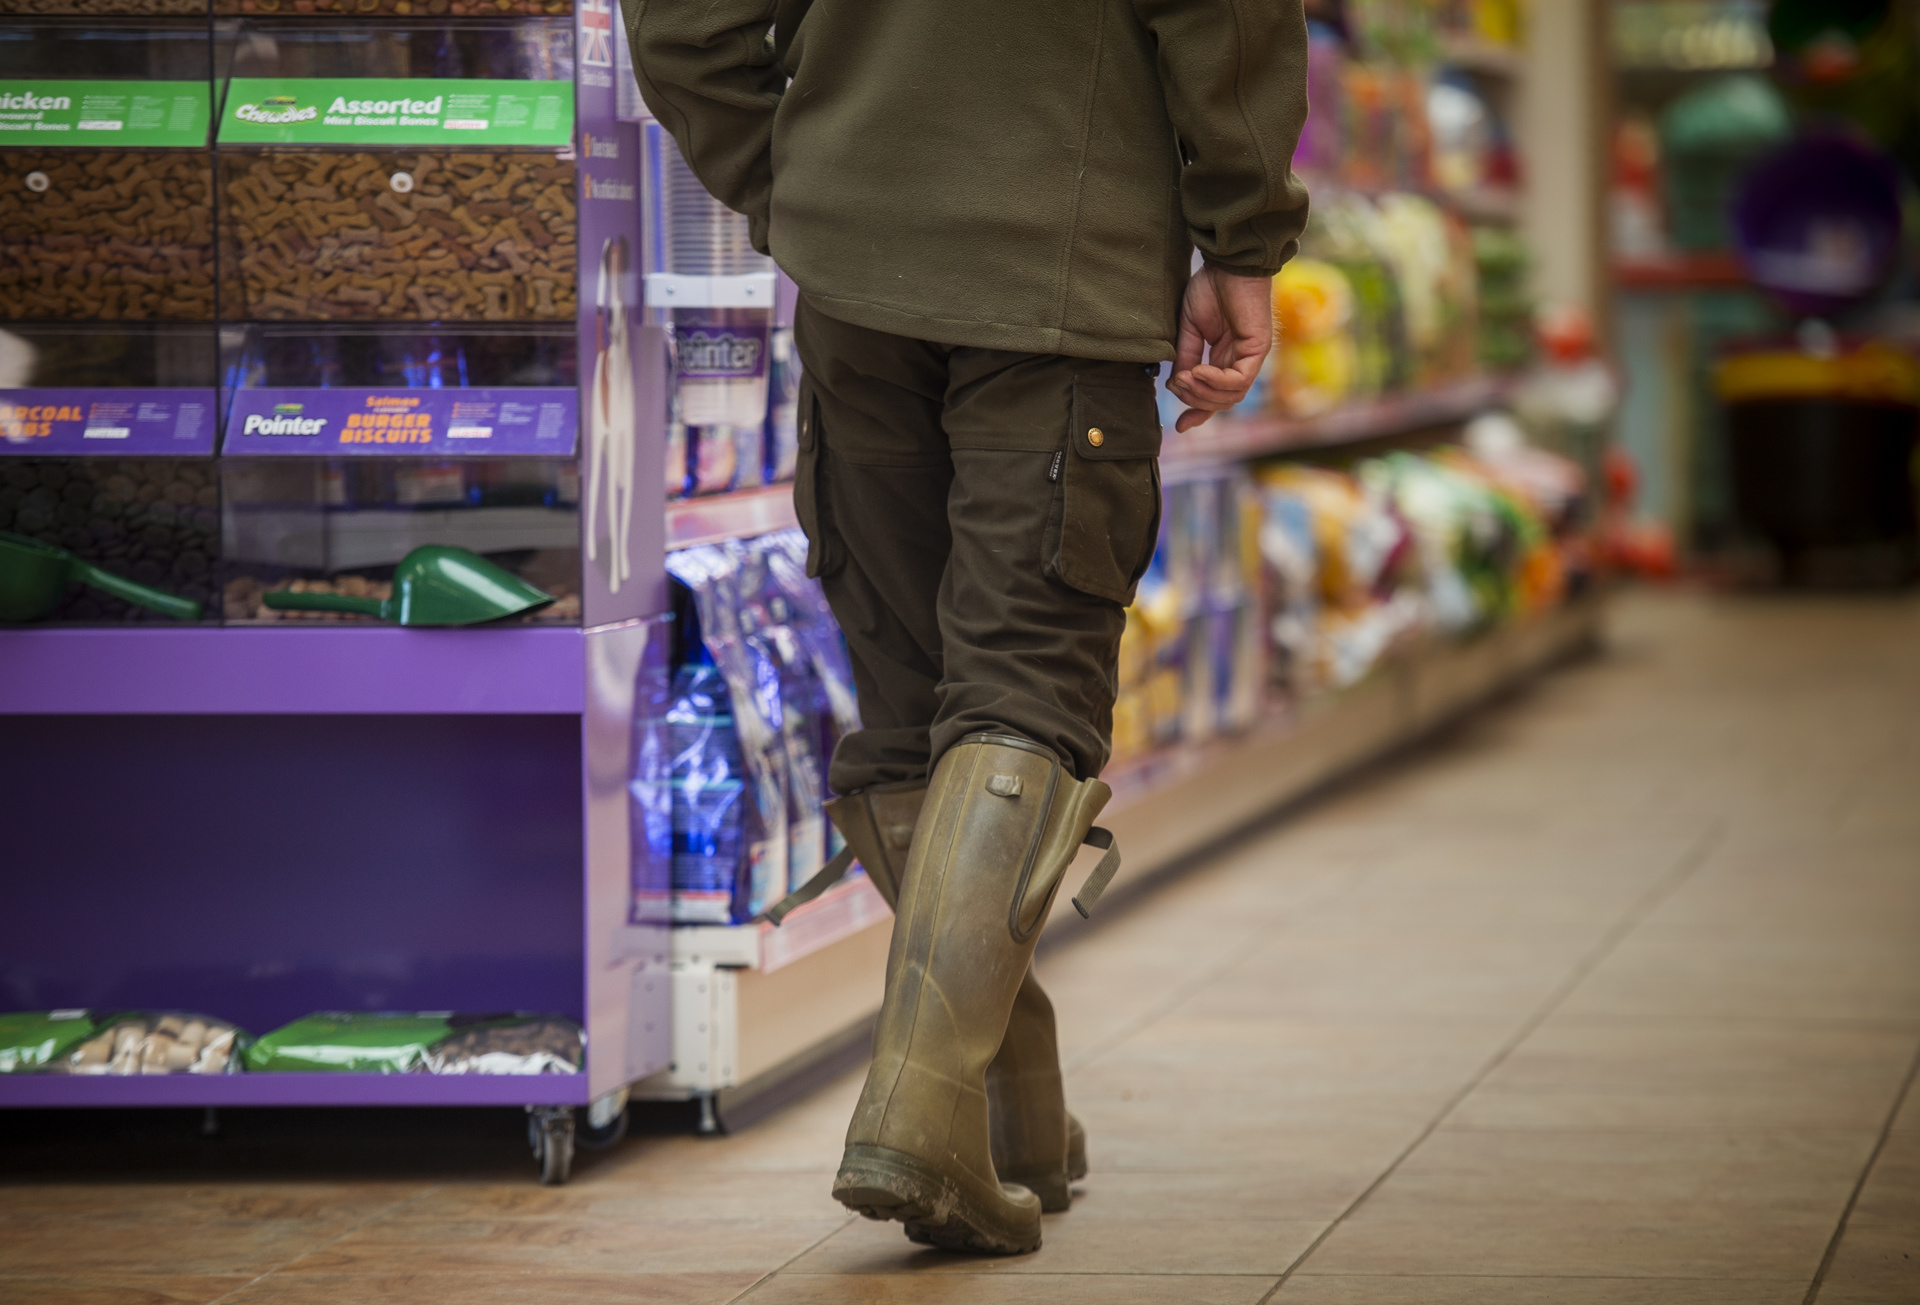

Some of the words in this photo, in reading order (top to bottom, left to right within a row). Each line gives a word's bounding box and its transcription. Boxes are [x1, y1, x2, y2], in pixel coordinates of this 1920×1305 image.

[0, 91, 71, 110] icken
[327, 95, 443, 114] Assorted
[33, 121, 71, 131] Bones
[323, 115, 352, 126] Mini
[354, 115, 396, 126] Biscuit
[399, 115, 438, 126] Bones
[365, 395, 420, 407] Salmon
[244, 414, 328, 436] Pointer
[346, 413, 432, 428] BURGER
[339, 429, 432, 443] BISCUITS
